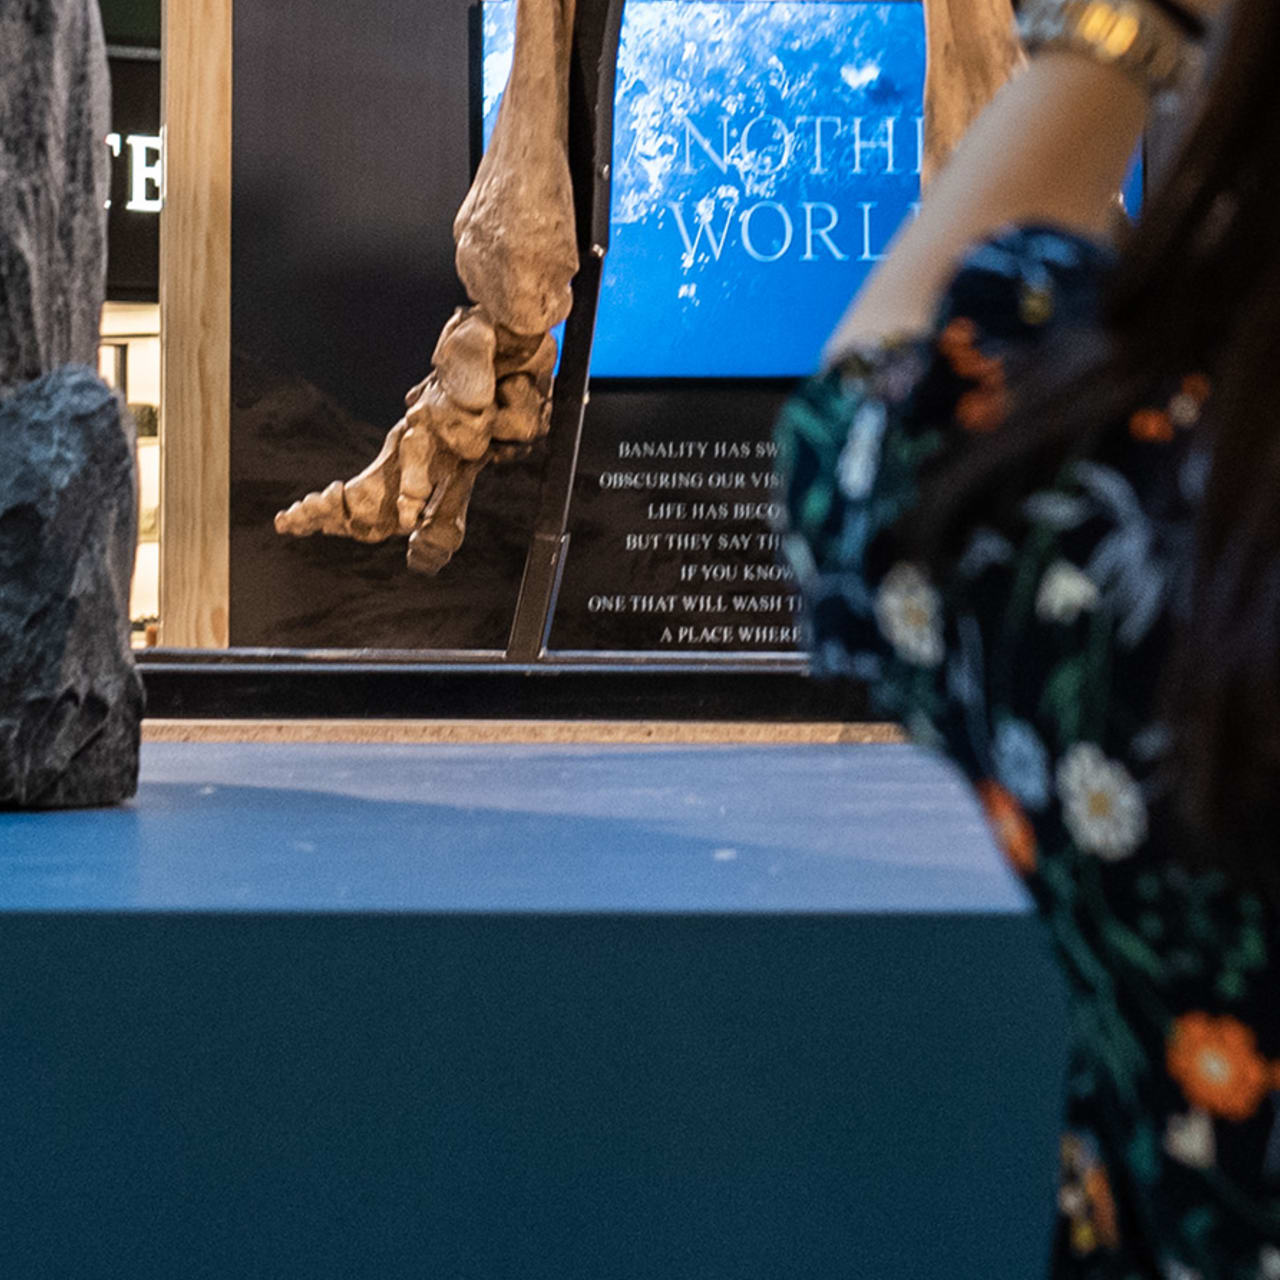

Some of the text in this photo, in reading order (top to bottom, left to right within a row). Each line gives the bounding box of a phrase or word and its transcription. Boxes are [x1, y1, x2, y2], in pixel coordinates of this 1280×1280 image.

[668, 200, 923, 263] WORL
[618, 441, 709, 459] BANALITY
[713, 441, 752, 458] HAS
[599, 472, 784, 489] OBSCURING OUR VIS
[648, 503, 687, 520] LIFE
[691, 503, 729, 520] HAS
[626, 533, 784, 551] BUT THEY SAY TH
[680, 564, 698, 582] IF
[701, 564, 739, 582] YOU
[587, 595, 627, 613] ONE
[630, 595, 678, 613] THAT
[681, 595, 728, 613] WILL
[732, 594, 783, 613] WASH
[660, 625, 803, 644] A PLACE WHERE
